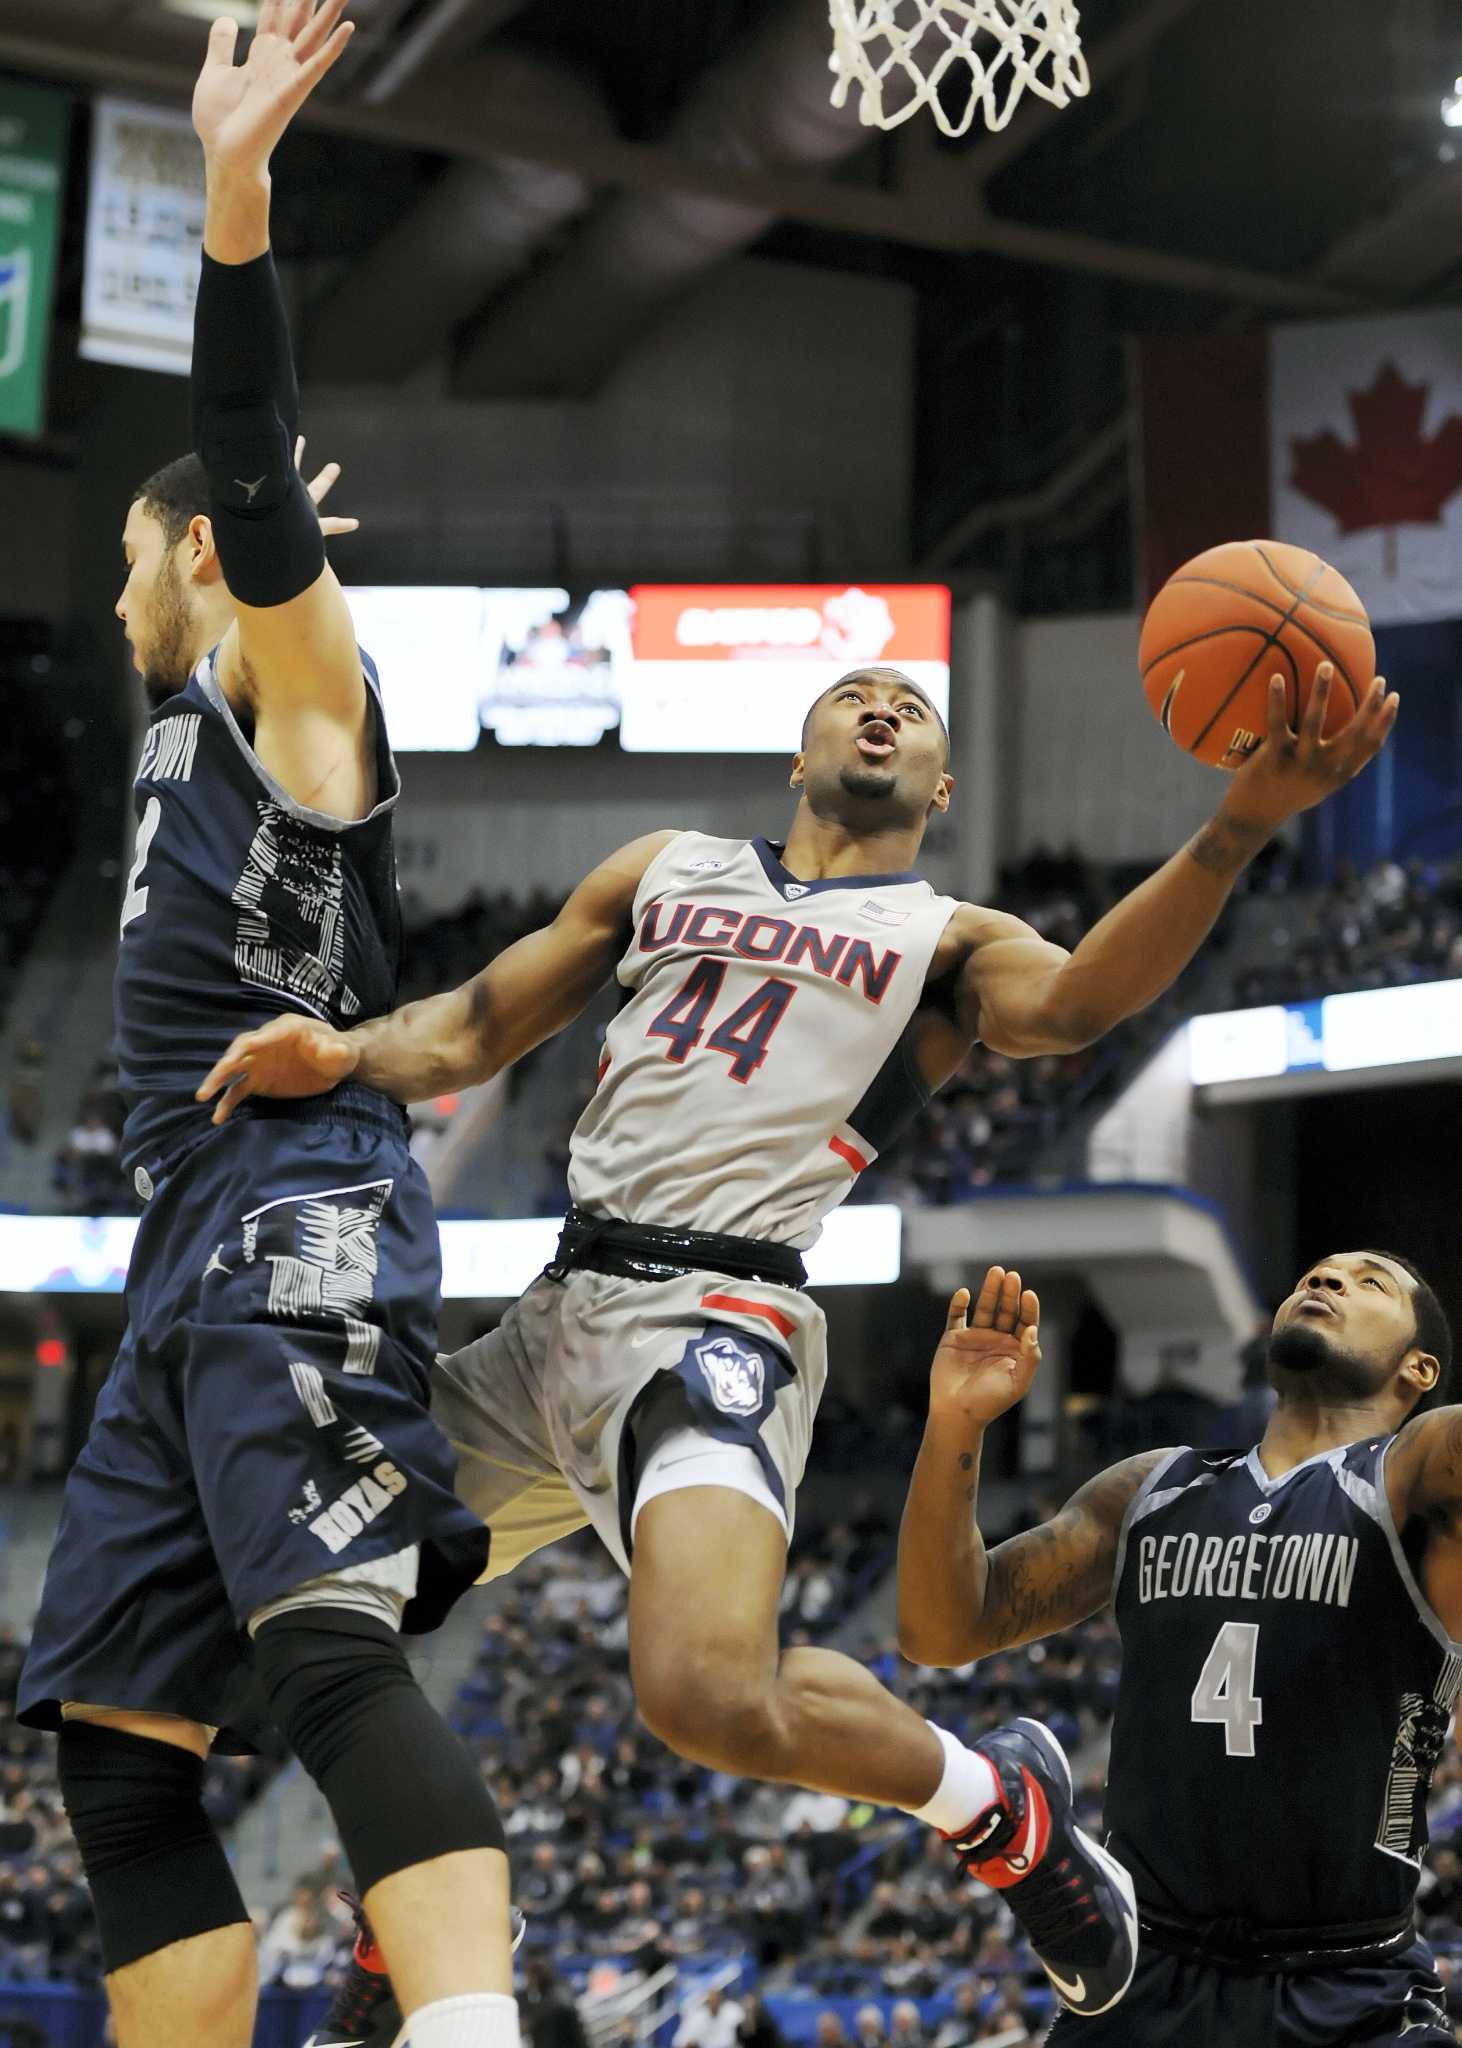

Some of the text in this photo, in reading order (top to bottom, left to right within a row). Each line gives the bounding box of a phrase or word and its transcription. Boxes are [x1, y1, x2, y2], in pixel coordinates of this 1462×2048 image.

[639, 902, 902, 1006] UCONN
[646, 956, 798, 1085] 44
[308, 1461, 408, 1554] HOYAS
[1139, 1532, 1359, 1608] GEORGETOWN
[1191, 1621, 1263, 1757] 4
